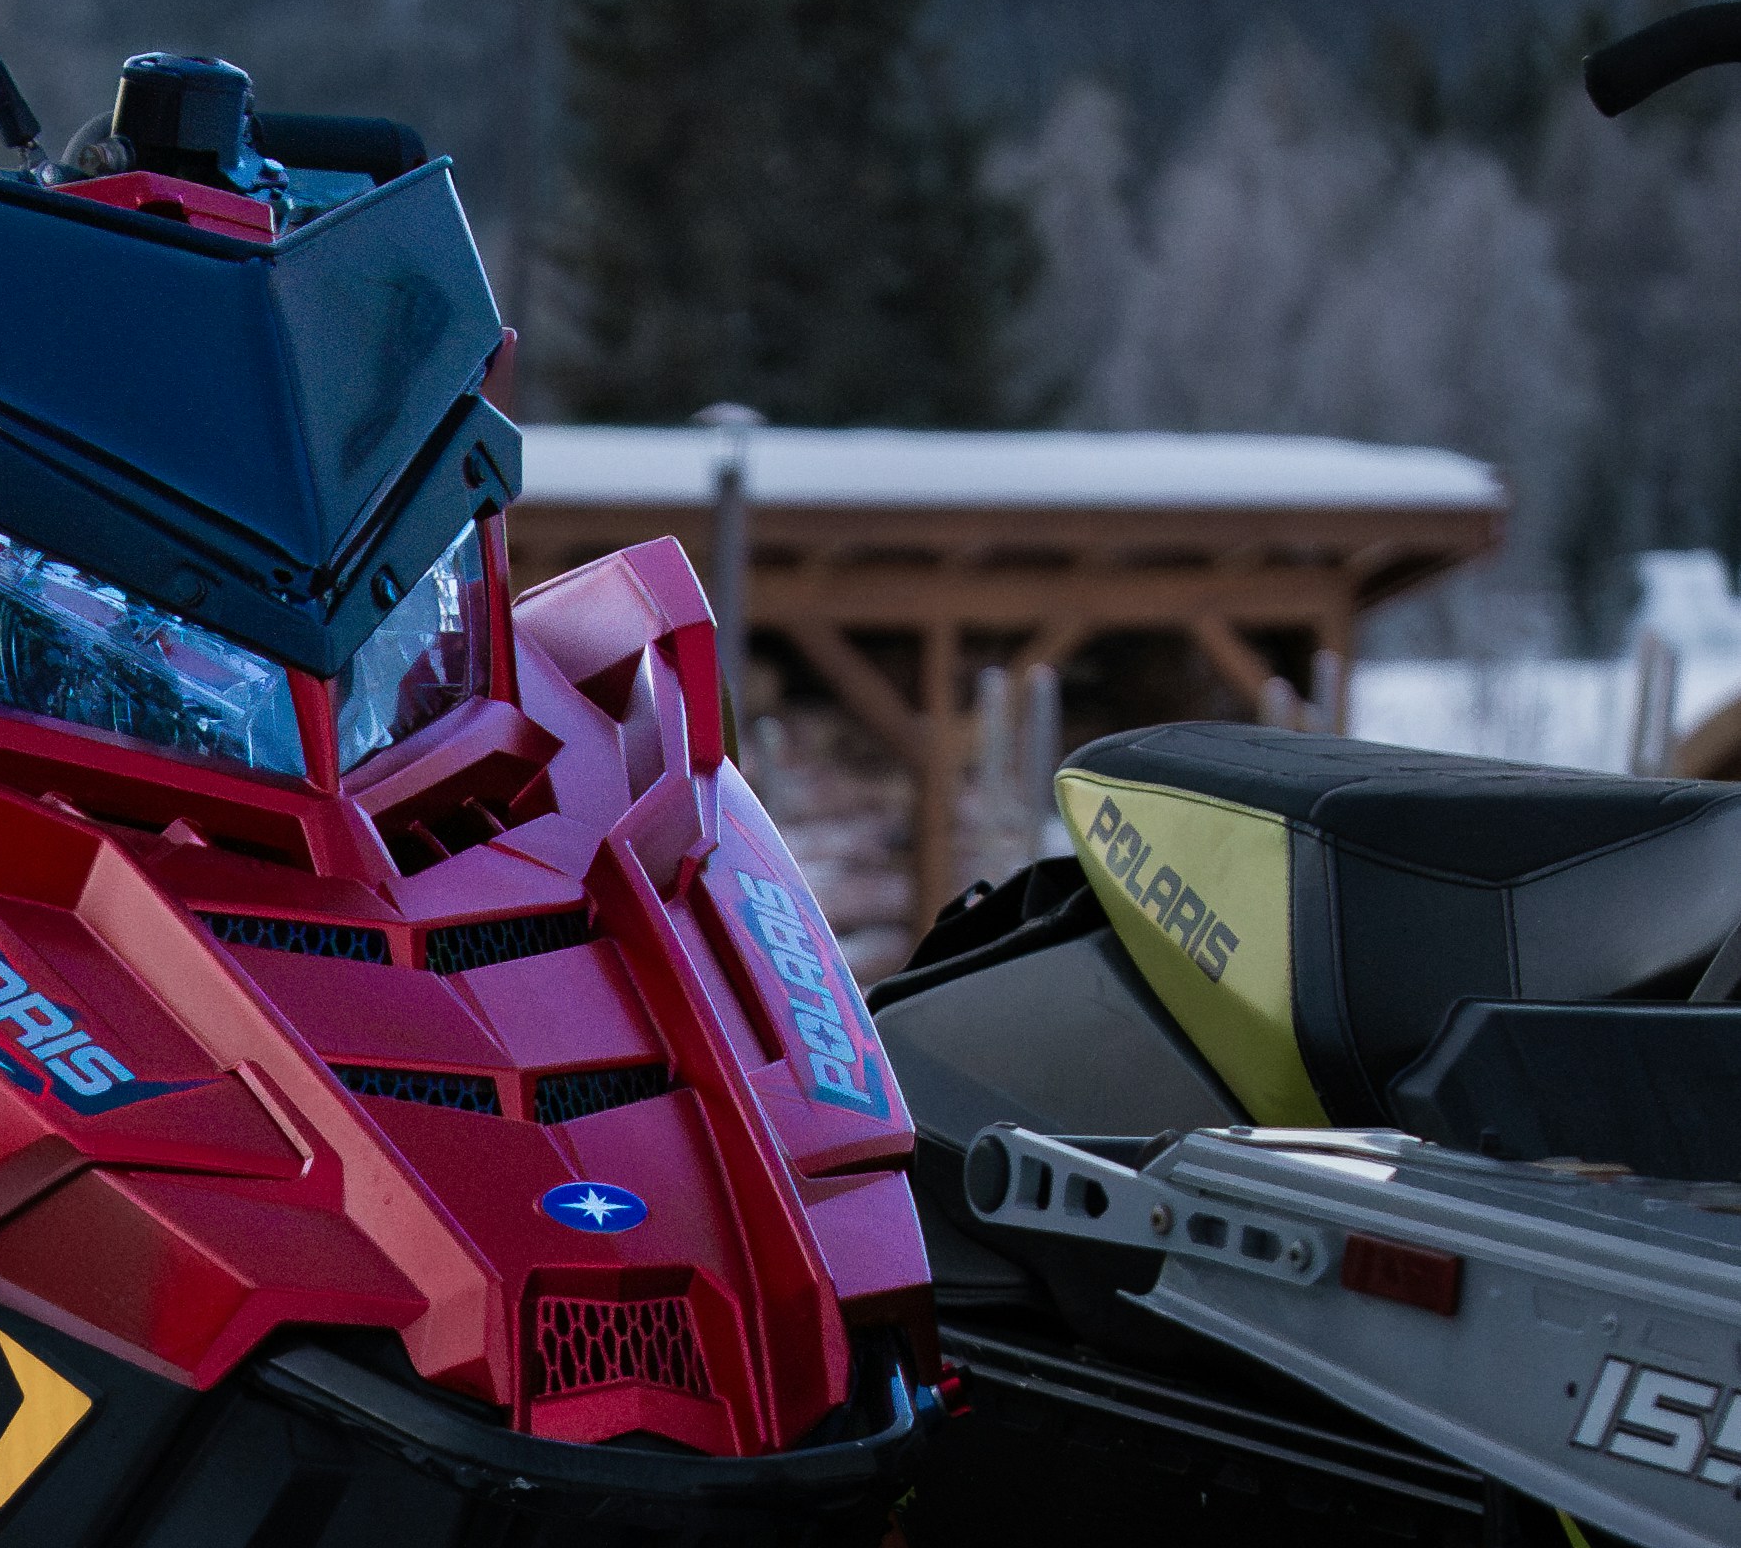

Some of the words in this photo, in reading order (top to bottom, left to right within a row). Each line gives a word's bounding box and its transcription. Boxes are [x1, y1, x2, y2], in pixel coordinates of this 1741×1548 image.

[1086, 796, 1240, 984] POLARIS
[734, 870, 872, 1104] POLARIS
[1569, 1353, 1741, 1491] 15
